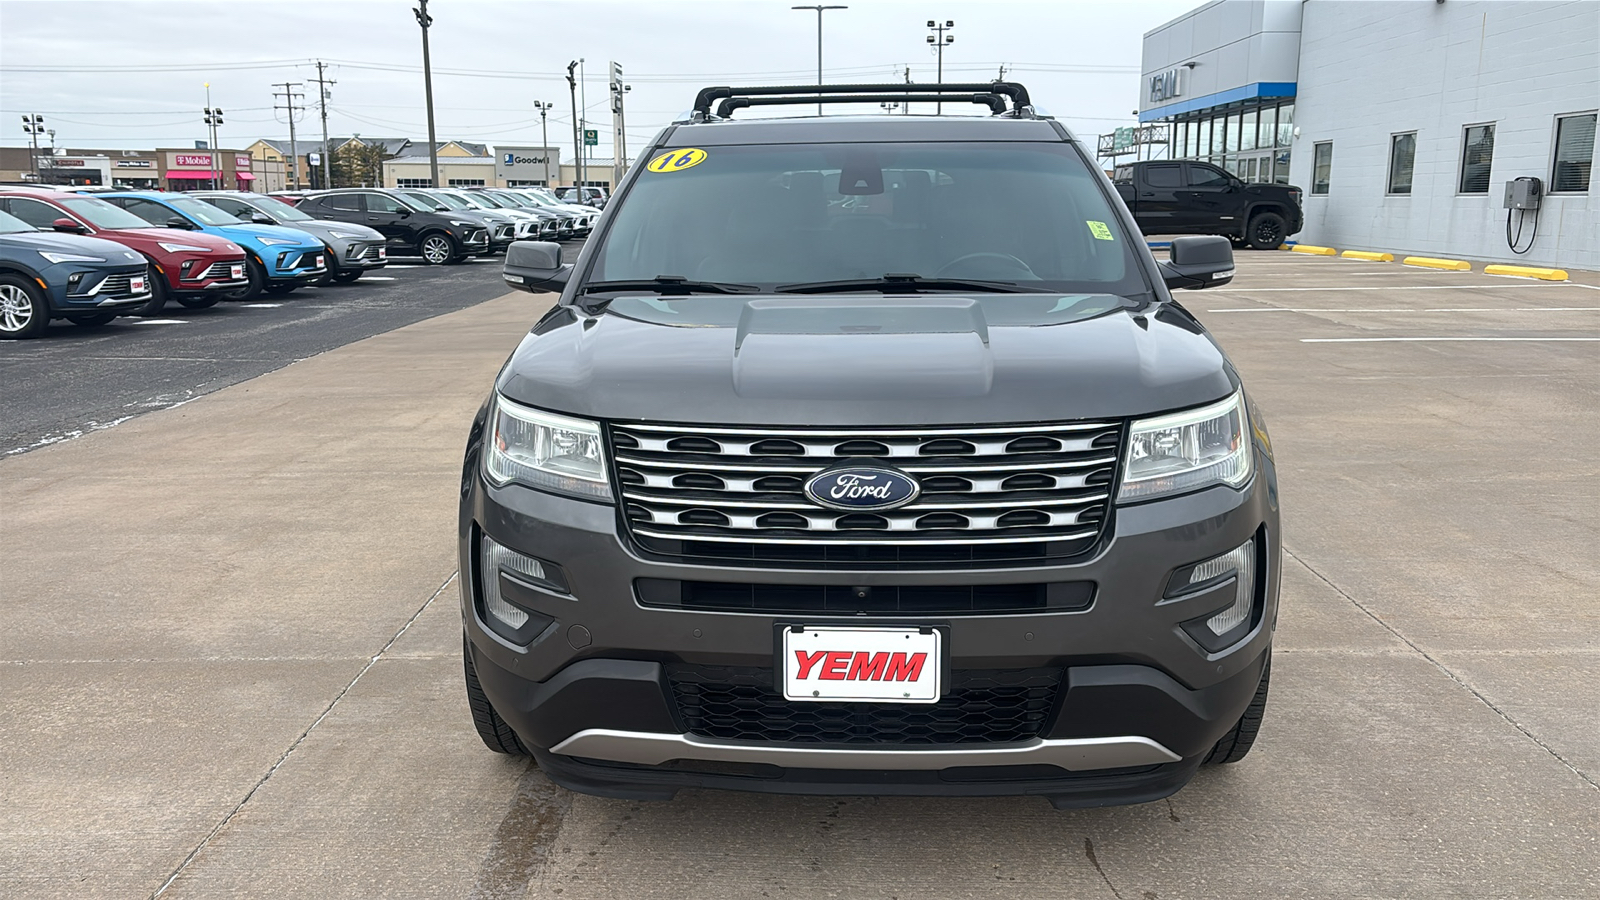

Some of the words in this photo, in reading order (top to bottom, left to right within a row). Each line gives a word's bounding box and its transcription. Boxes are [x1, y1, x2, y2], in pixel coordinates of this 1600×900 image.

[185, 156, 210, 165] Mobile
[514, 156, 550, 164] Goodwil
[657, 150, 695, 170] 16
[830, 473, 893, 499] Ford
[794, 650, 928, 682] YEMM
